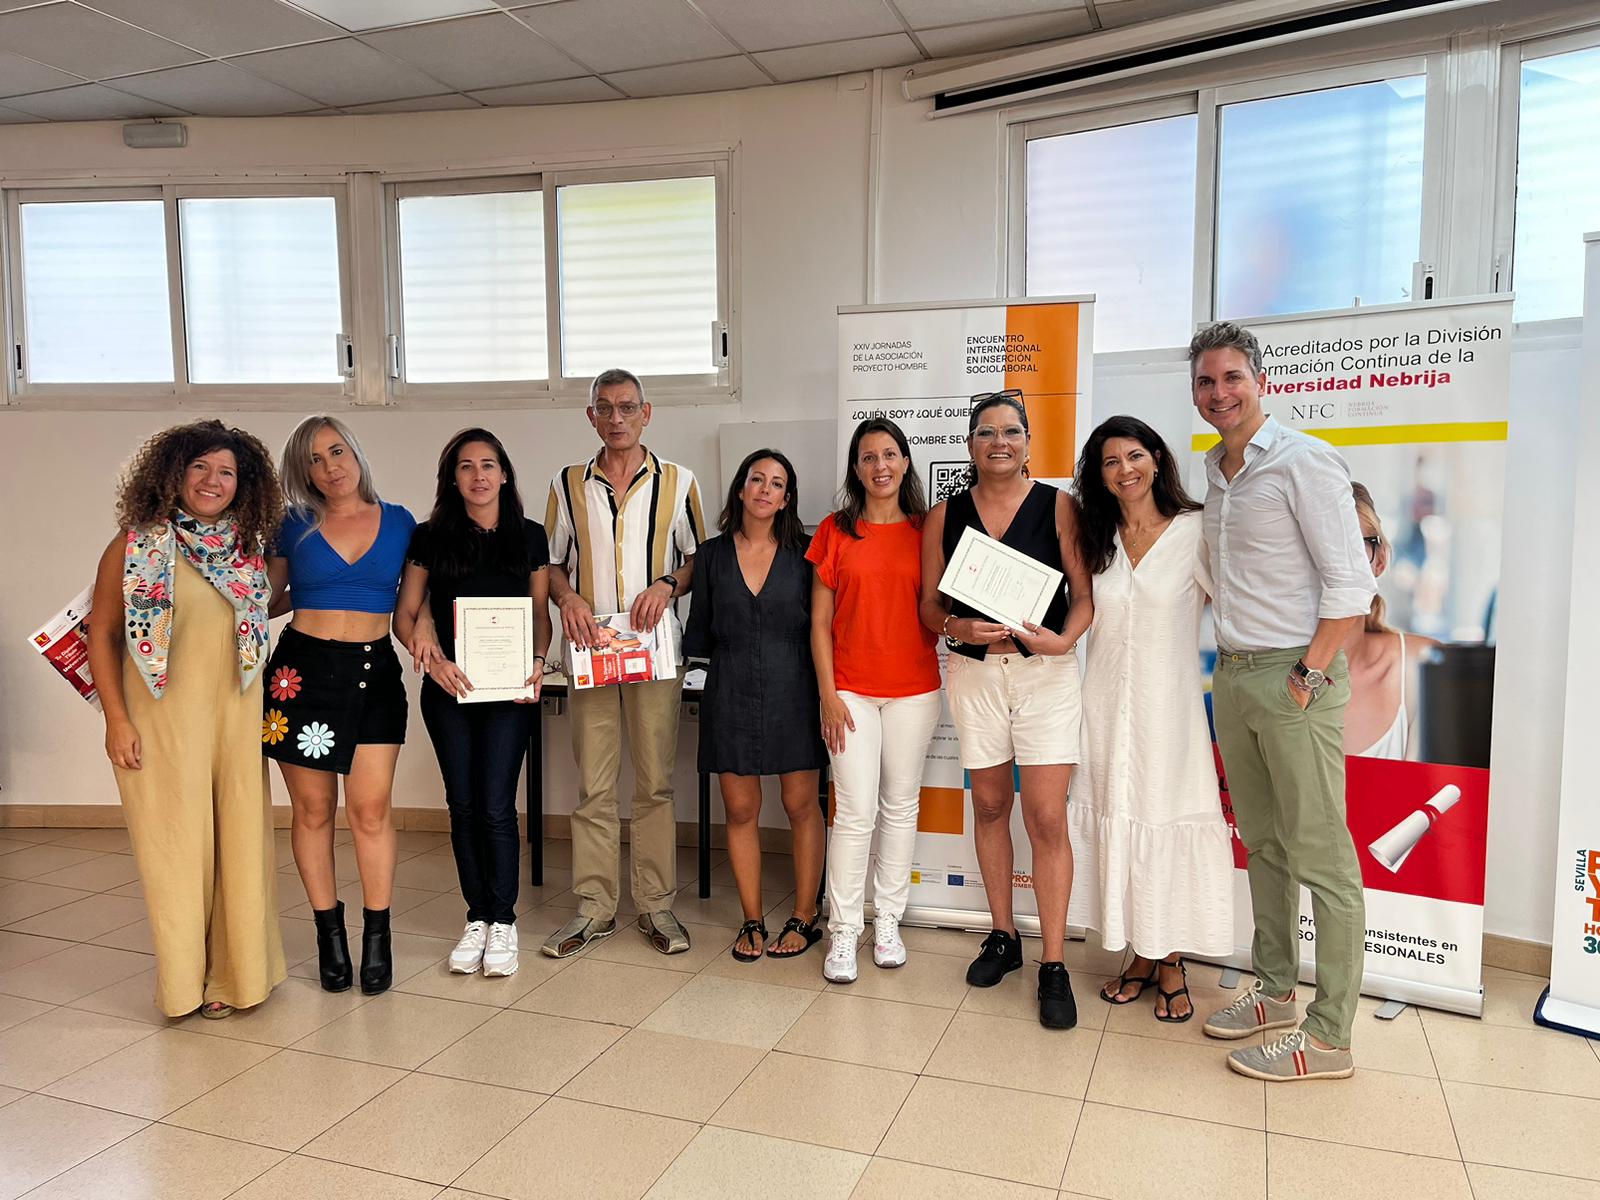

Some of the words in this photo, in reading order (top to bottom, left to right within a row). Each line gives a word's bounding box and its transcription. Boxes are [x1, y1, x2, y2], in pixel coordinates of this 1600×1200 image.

[966, 334, 1024, 344] ENCUENTRO
[1262, 338, 1363, 358] Acreditados
[1369, 336, 1399, 353] por
[1405, 332, 1420, 346] la
[1427, 325, 1501, 344] División
[853, 343, 870, 351] XXIV
[871, 341, 912, 350] JORNADAS
[966, 344, 1041, 354] INTERNACIONAL
[864, 353, 874, 361] LA
[875, 351, 923, 360] ASOCIACIÓN
[966, 356, 979, 364] EN
[980, 353, 1031, 363] INSERCIÓN
[853, 364, 893, 372] PROYECTO
[894, 362, 928, 371] HOMBRE
[1261, 359, 1334, 376] ormación
[1341, 353, 1421, 371] Continua
[1428, 349, 1451, 364] de
[1459, 348, 1474, 363] la
[966, 364, 1038, 374] SOCIOLABORAL
[1266, 375, 1361, 395] iversidad
[1369, 370, 1451, 388] Nebrija
[852, 408, 887, 420] ¿QUIÉN
[889, 409, 914, 419] SOY?
[916, 406, 942, 418] ¿QUÉ
[944, 408, 973, 418] QUIER
[1291, 403, 1335, 420] NFC
[1574, 849, 1587, 892] SEVILLA
[1441, 942, 1458, 952] en
[1364, 942, 1445, 965] ESIONALES
